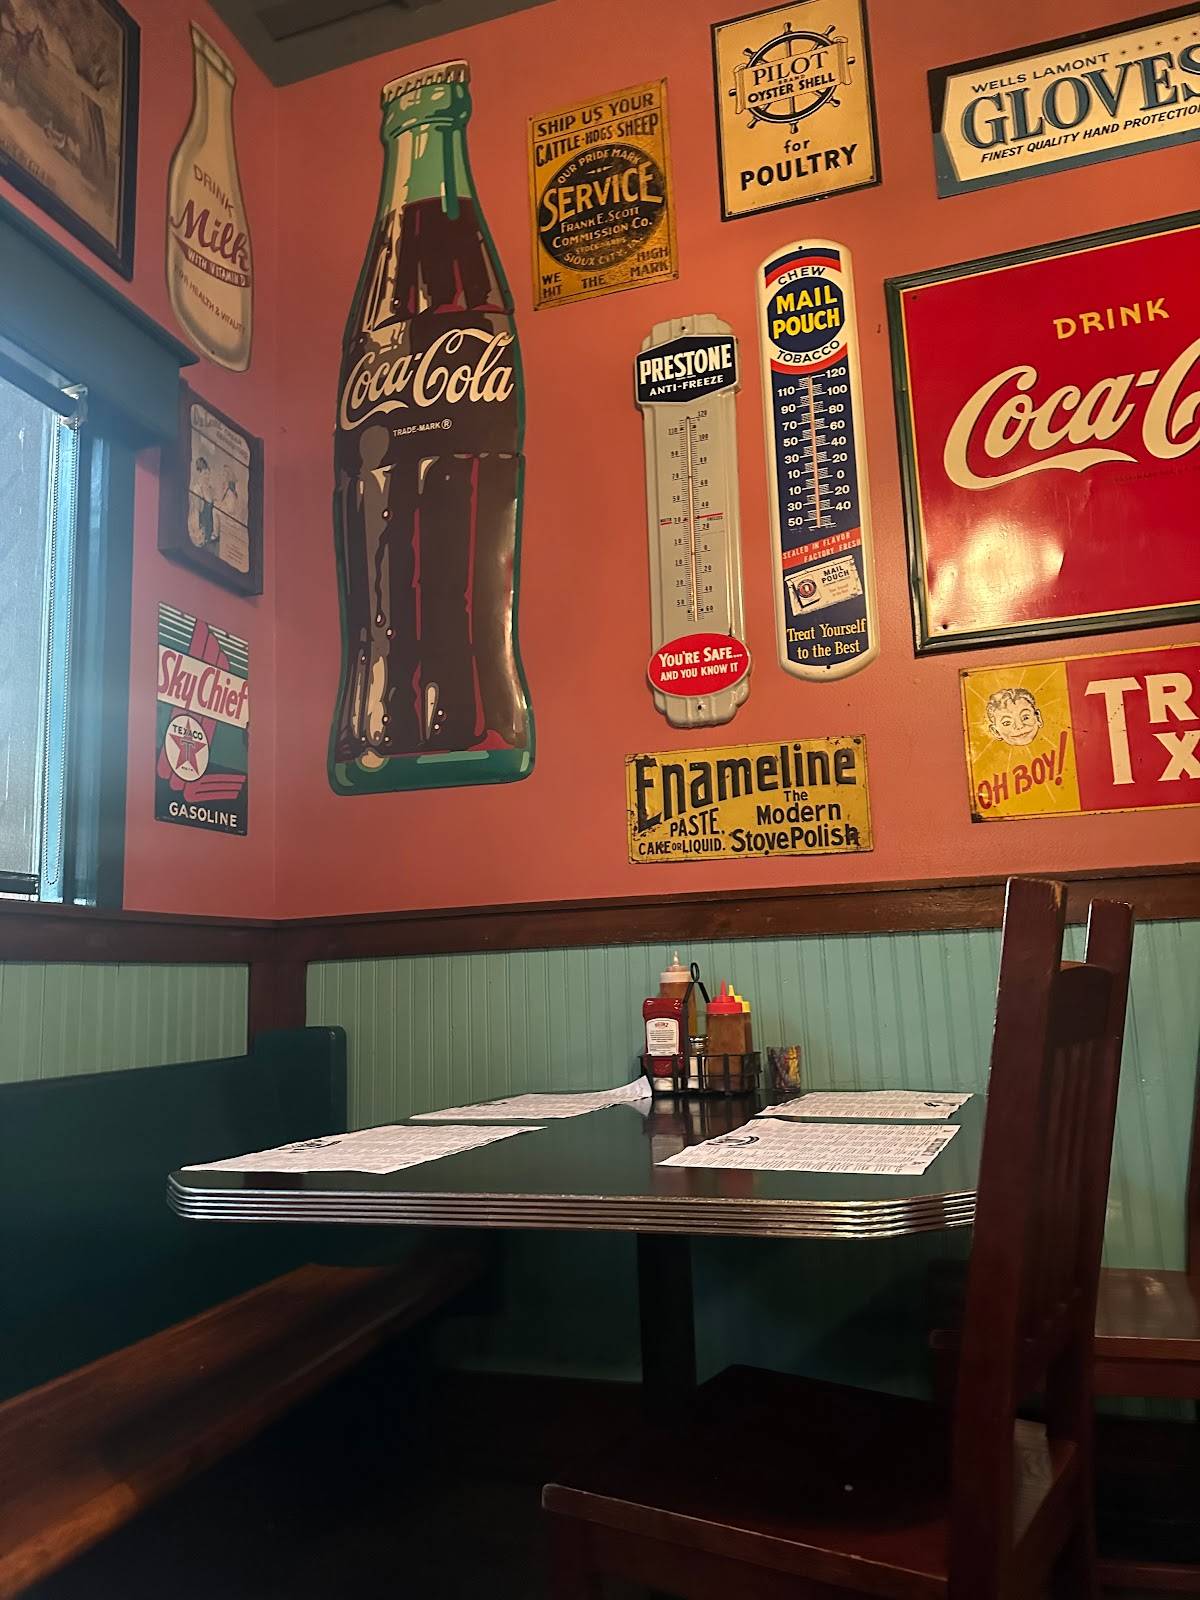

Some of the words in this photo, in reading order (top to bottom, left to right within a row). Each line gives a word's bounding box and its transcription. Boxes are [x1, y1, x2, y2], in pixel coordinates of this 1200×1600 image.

[752, 50, 829, 87] PILOT
[971, 73, 1028, 94] WELLS
[1032, 52, 1110, 80] LAMONT
[748, 82, 795, 104] OYSTER
[799, 73, 836, 91] SHELL
[537, 115, 576, 138] SHIP
[581, 105, 603, 125] US
[608, 92, 654, 118] YOUR
[617, 112, 659, 137] SHEEP
[980, 145, 1023, 163] FINEST
[1026, 131, 1080, 154] QUALITY
[1083, 123, 1120, 140] HAND
[1123, 104, 1200, 130] PROTECTIO
[783, 138, 810, 154] for
[557, 163, 578, 184] OUR
[578, 149, 611, 167] PRIDE
[611, 148, 642, 165] MARK
[740, 143, 858, 191] POULTRY
[193, 163, 234, 218] DRINK
[540, 160, 663, 233] SERVICE
[169, 199, 250, 272] Milk
[551, 223, 629, 248] COMMISSION
[560, 218, 596, 234] FRANK
[563, 251, 597, 267] SIOUX
[636, 246, 669, 263] HIGH
[541, 271, 562, 286] WE
[630, 261, 669, 277] MARK
[777, 266, 826, 285] CHEW
[542, 285, 563, 299] HIT
[581, 274, 607, 290] THE
[776, 284, 838, 315] MAIL
[772, 307, 841, 339] POUCH
[1053, 297, 1170, 340] DRINK
[776, 340, 840, 363] TOBACCO
[639, 343, 733, 385] PRESTONE
[825, 366, 846, 379] 120
[340, 327, 515, 431] Coca-Cola
[649, 374, 724, 397] ANTI-FREEZE
[777, 386, 796, 397] 110
[827, 384, 848, 396] 100
[780, 404, 796, 414] 90
[828, 403, 844, 414] 80
[782, 420, 798, 431] 70
[829, 420, 845, 430] 60
[783, 437, 798, 447] 50
[831, 436, 847, 446] 40
[784, 454, 800, 464] 30
[832, 452, 848, 463] 20
[787, 469, 801, 480] 10
[836, 470, 845, 479] 0
[788, 485, 802, 496] 10
[834, 484, 850, 495] 20
[787, 501, 802, 512] 30
[835, 500, 851, 511] 40
[787, 516, 803, 527] 50
[782, 545, 809, 560] SEALED
[822, 531, 851, 546] FLAVOR
[803, 547, 834, 563] FACTORY
[821, 570, 850, 584] POUCH
[823, 565, 844, 577] MAIL
[786, 626, 815, 642] Treat
[819, 618, 867, 638] Yourself
[797, 646, 809, 660] to
[812, 643, 832, 657] the
[834, 639, 860, 655] Best
[660, 670, 679, 681] AND
[680, 667, 698, 679] YOU
[701, 663, 728, 676] KNOW
[730, 662, 739, 672] IT
[157, 649, 198, 710] Sky
[197, 666, 248, 720] Chief
[172, 724, 204, 741] TEXACO
[977, 772, 1009, 810] OH
[1012, 730, 1068, 795] BOY!
[635, 743, 857, 834] Enameline
[783, 789, 809, 803] The
[168, 801, 238, 828] GASOLINE
[669, 807, 726, 838] PASTE.
[756, 802, 842, 826] Modern
[638, 840, 671, 856] CAKE
